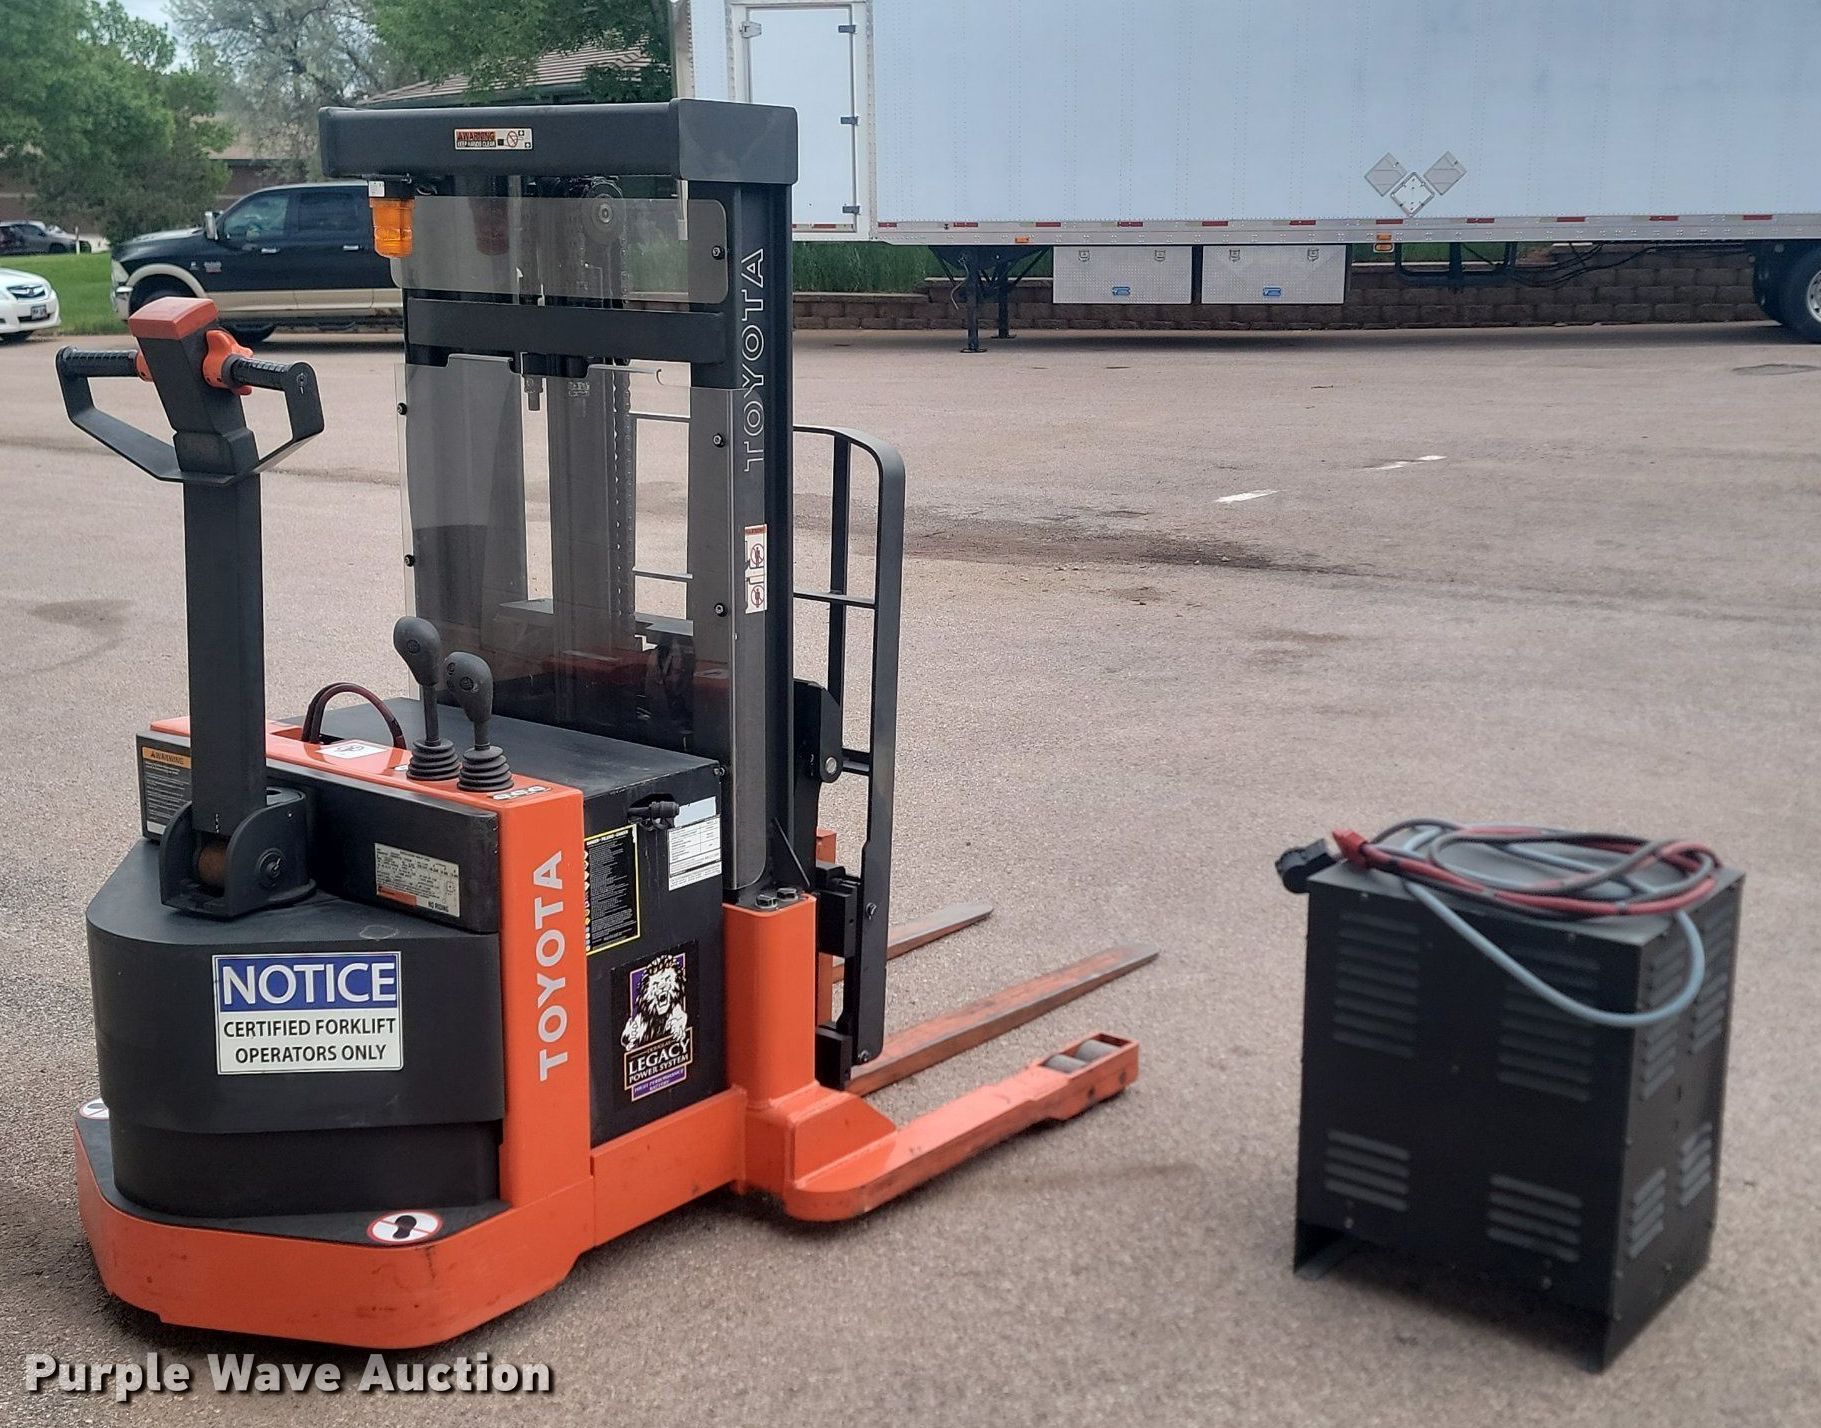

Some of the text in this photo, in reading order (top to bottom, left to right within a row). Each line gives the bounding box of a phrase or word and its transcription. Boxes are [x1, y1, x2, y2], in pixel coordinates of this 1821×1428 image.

[462, 131, 496, 140] WARNING
[741, 249, 764, 472] TOYOTA
[533, 850, 568, 1082] TOYOTA
[222, 962, 397, 1005] NOTICE
[223, 1017, 397, 1038] CERTIFIED FORKLIFT
[235, 1044, 387, 1064] OPERATORS ONLY
[628, 1038, 690, 1076] LEGACY
[628, 1053, 689, 1084] POWER SYSTEM
